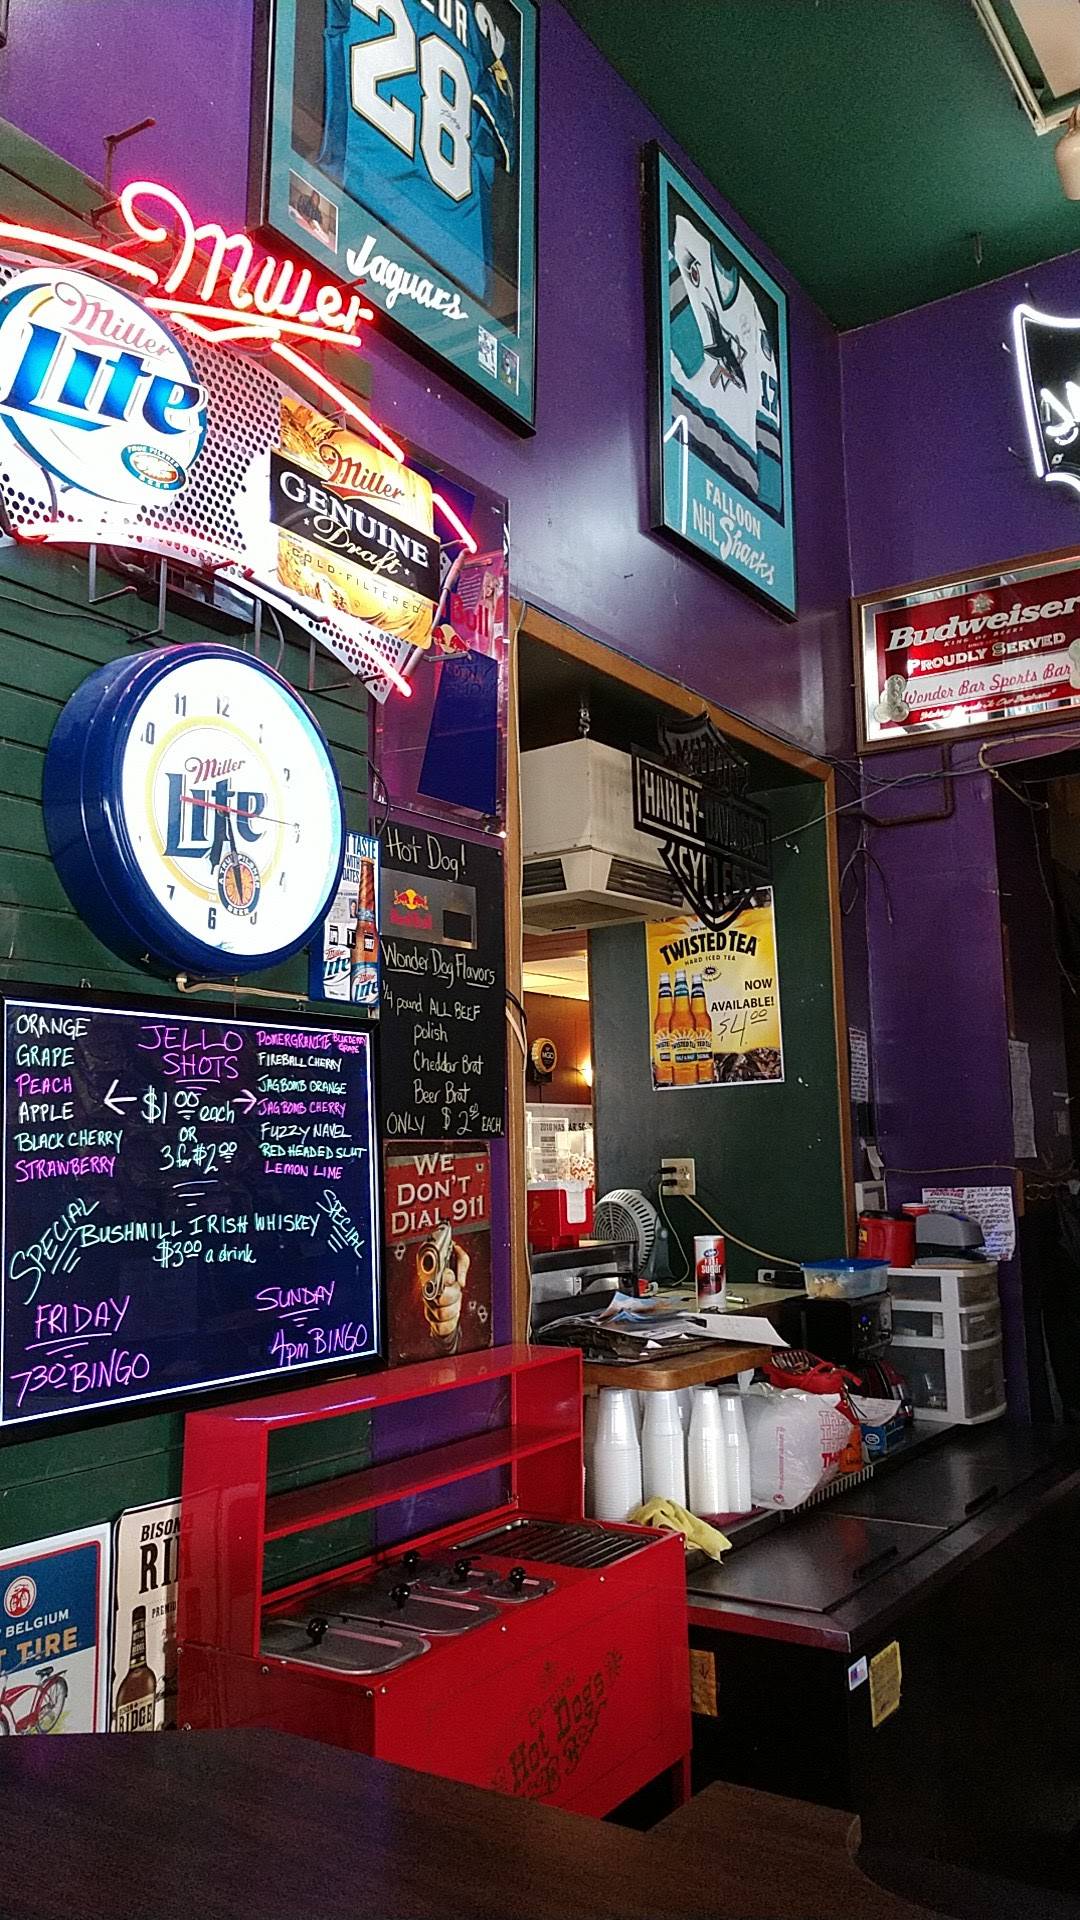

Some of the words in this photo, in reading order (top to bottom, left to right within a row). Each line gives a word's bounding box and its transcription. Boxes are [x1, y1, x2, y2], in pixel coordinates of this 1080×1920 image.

[351, 0, 473, 202] 28
[346, 234, 469, 320] Jaguars
[55, 280, 173, 357] Miller
[3, 321, 201, 435] Lite
[318, 443, 406, 499] Miller
[279, 471, 429, 568] GENUINE
[705, 479, 762, 541] FALLOON
[312, 514, 402, 576] Draft
[692, 497, 720, 549] NHL
[720, 517, 775, 587] Sharks
[291, 547, 421, 614] COLD-FILTERED
[885, 596, 1080, 651] Budweiser
[907, 647, 988, 675] PROUDLY
[991, 632, 1066, 656] SERVED
[904, 685, 953, 705] Wonder
[958, 680, 985, 694] Bar
[990, 671, 1037, 692] Sports
[1043, 663, 1071, 678] Bar
[185, 756, 246, 785] Miller
[163, 772, 268, 859] Lite
[386, 827, 422, 864] Hot
[427, 834, 466, 882] Dog!
[208, 906, 217, 930] 6
[660, 932, 727, 966] TWISTED
[728, 930, 758, 957] TEA
[380, 940, 430, 970] Wonder
[429, 948, 454, 988] Dog
[455, 953, 495, 983] Flavors
[744, 978, 772, 990] NOW
[396, 993, 424, 1016] pound
[429, 997, 453, 1019] ALL
[453, 1004, 481, 1022] BEEF
[711, 996, 774, 1013] AVAILABLE!
[16, 1013, 91, 1040] ORANGE
[137, 1025, 244, 1052] JELLO
[413, 1023, 448, 1047] polish
[16, 1044, 75, 1067] GRAPE
[162, 1053, 239, 1079] SHOTS
[257, 1052, 307, 1068] FIREBALL
[307, 1055, 343, 1072] CHERRY
[413, 1050, 460, 1075] Cheddar
[461, 1054, 484, 1076] Brat
[15, 1073, 73, 1097] PEACH
[308, 1080, 347, 1095] ORANGE
[413, 1078, 442, 1105] Beer
[445, 1081, 471, 1105] Brat
[18, 1101, 75, 1124] APPLE
[199, 1100, 236, 1124] each
[309, 1102, 347, 1118] CHERRY
[386, 1111, 426, 1137] ONLY
[14, 1132, 65, 1152] BLACK
[68, 1129, 123, 1154] CHERRY
[179, 1126, 198, 1143] OR
[260, 1122, 311, 1144] FUZZY
[159, 1145, 175, 1170] 3
[259, 1143, 286, 1158] RED
[287, 1145, 334, 1159] HEADED
[335, 1147, 368, 1159] SLUT
[413, 1152, 454, 1177] WE
[16, 1156, 117, 1183] STRAWBERRY
[265, 1160, 309, 1177] LEMON
[313, 1164, 344, 1180] LIME
[397, 1175, 472, 1207] DON'T
[316, 1189, 365, 1259] SPECIAL
[391, 1207, 441, 1235] DIAL
[452, 1195, 485, 1222] 911
[75, 1220, 182, 1248] BUSHMILL
[188, 1214, 249, 1236] IRISH
[254, 1212, 321, 1237] WHISKEY
[9, 1198, 101, 1305] SPECIAL
[205, 1250, 214, 1263] a
[218, 1243, 257, 1264] drink
[256, 1281, 336, 1312] SUNDAY
[35, 1295, 131, 1339] FRIDAY
[271, 1328, 309, 1367] 4pm
[307, 1322, 368, 1354] BINGO
[70, 1348, 150, 1393] BINGO
[5, 1608, 70, 1638] BELGIUM
[17, 1626, 79, 1664] TIRE
